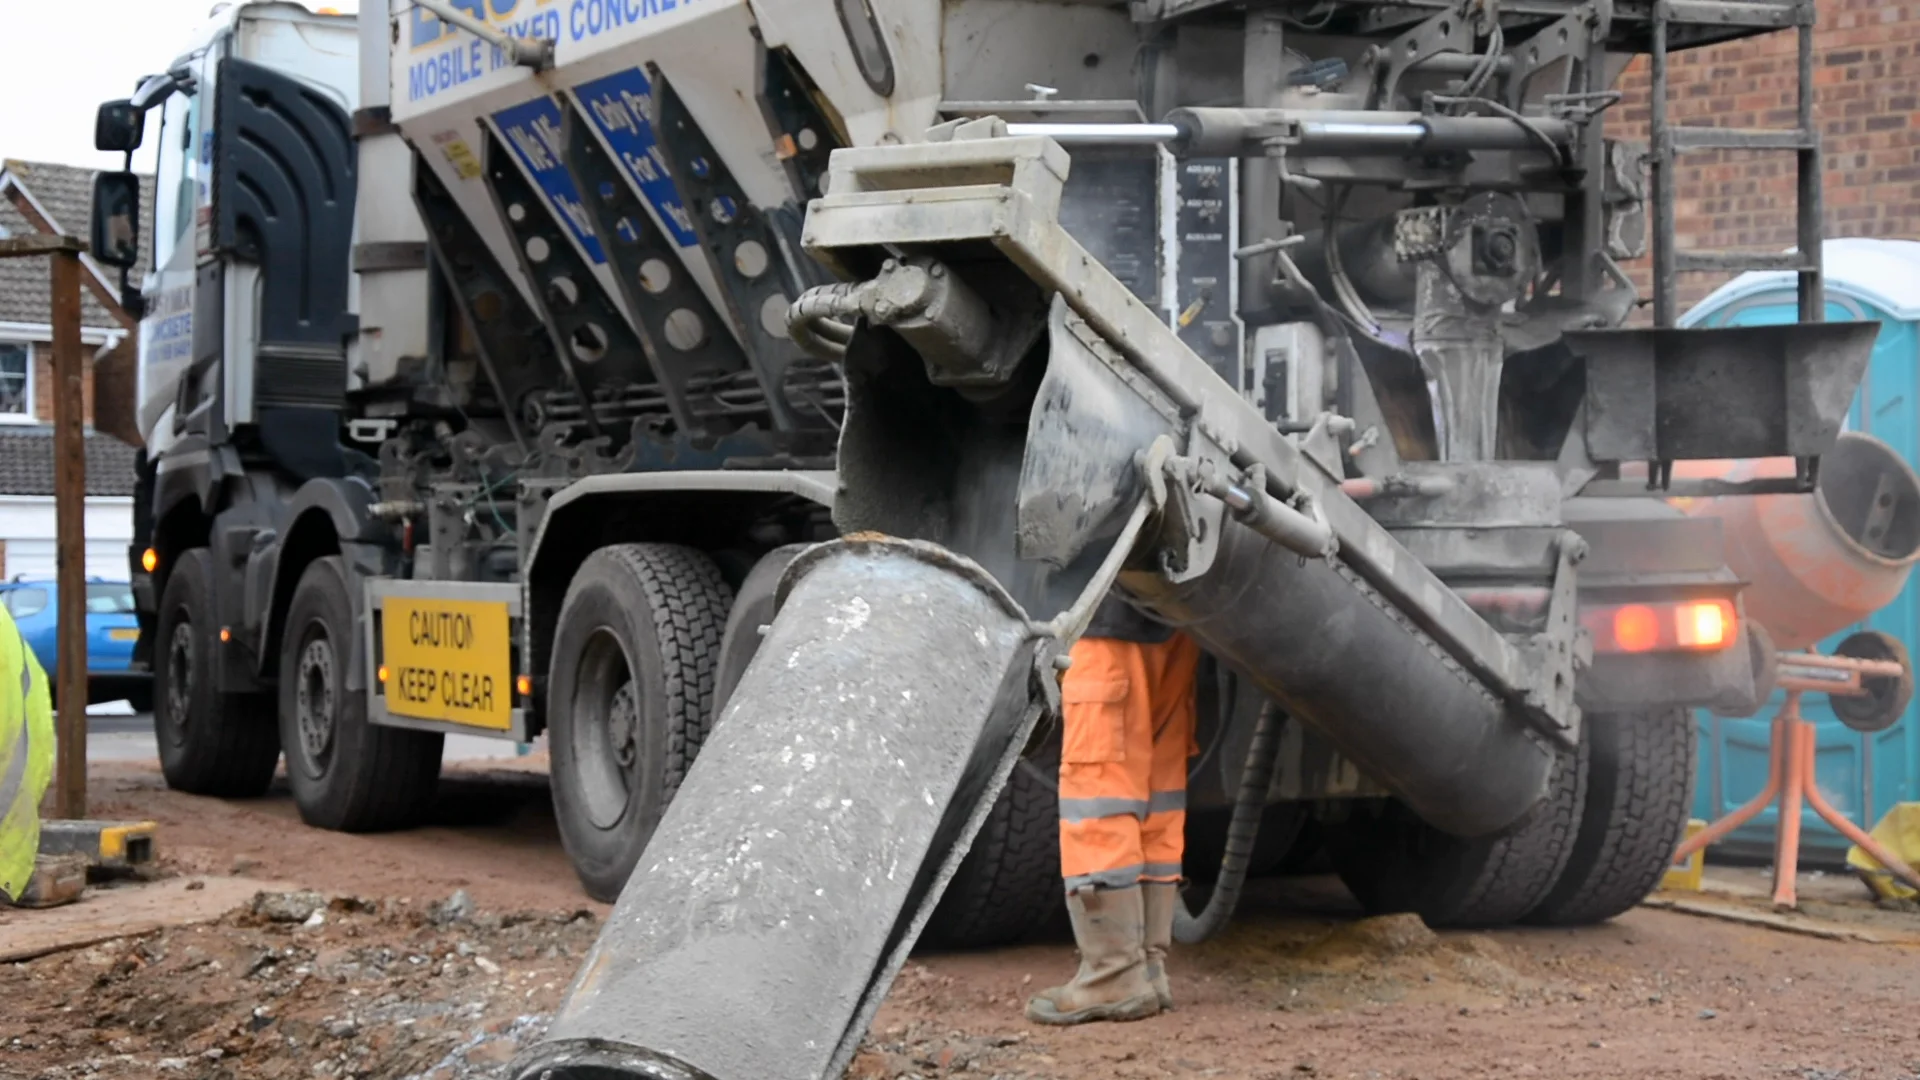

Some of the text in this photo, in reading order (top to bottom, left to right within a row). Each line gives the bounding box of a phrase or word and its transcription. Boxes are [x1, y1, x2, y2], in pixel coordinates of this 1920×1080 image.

[409, 39, 482, 102] MOBILE
[410, 609, 475, 649] CAUTION
[398, 666, 494, 712] KEEP CLEAR
